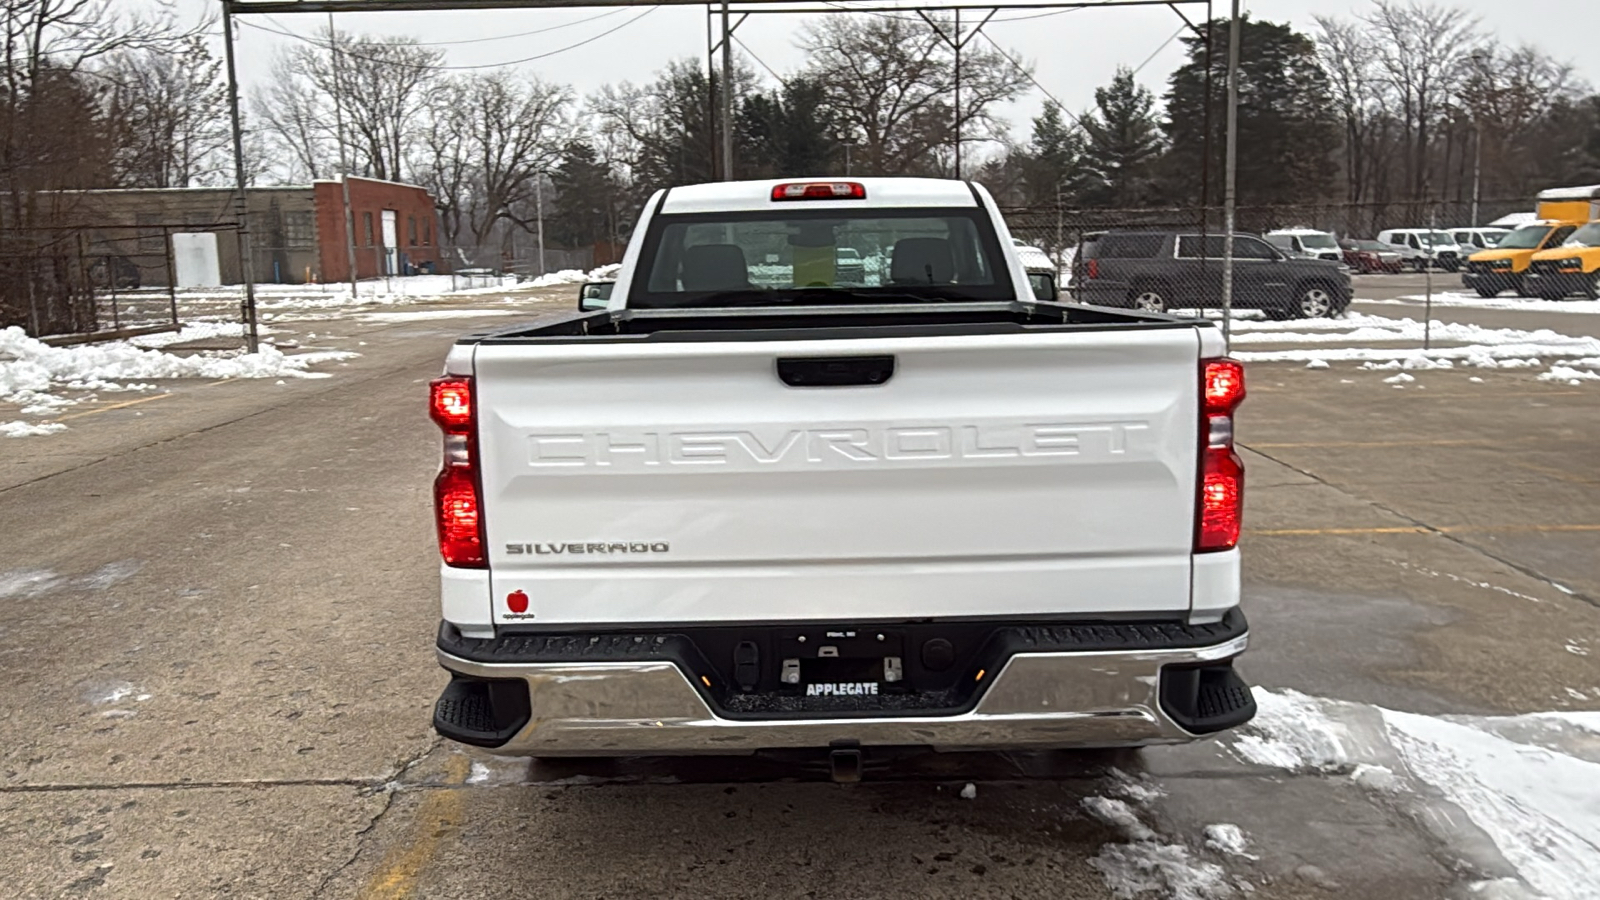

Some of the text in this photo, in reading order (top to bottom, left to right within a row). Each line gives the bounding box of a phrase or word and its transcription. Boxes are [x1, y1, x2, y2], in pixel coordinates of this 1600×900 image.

[527, 420, 1149, 467] CHEVROLET
[505, 542, 670, 555] SILVERADO
[806, 682, 879, 697] APPLEGATE
